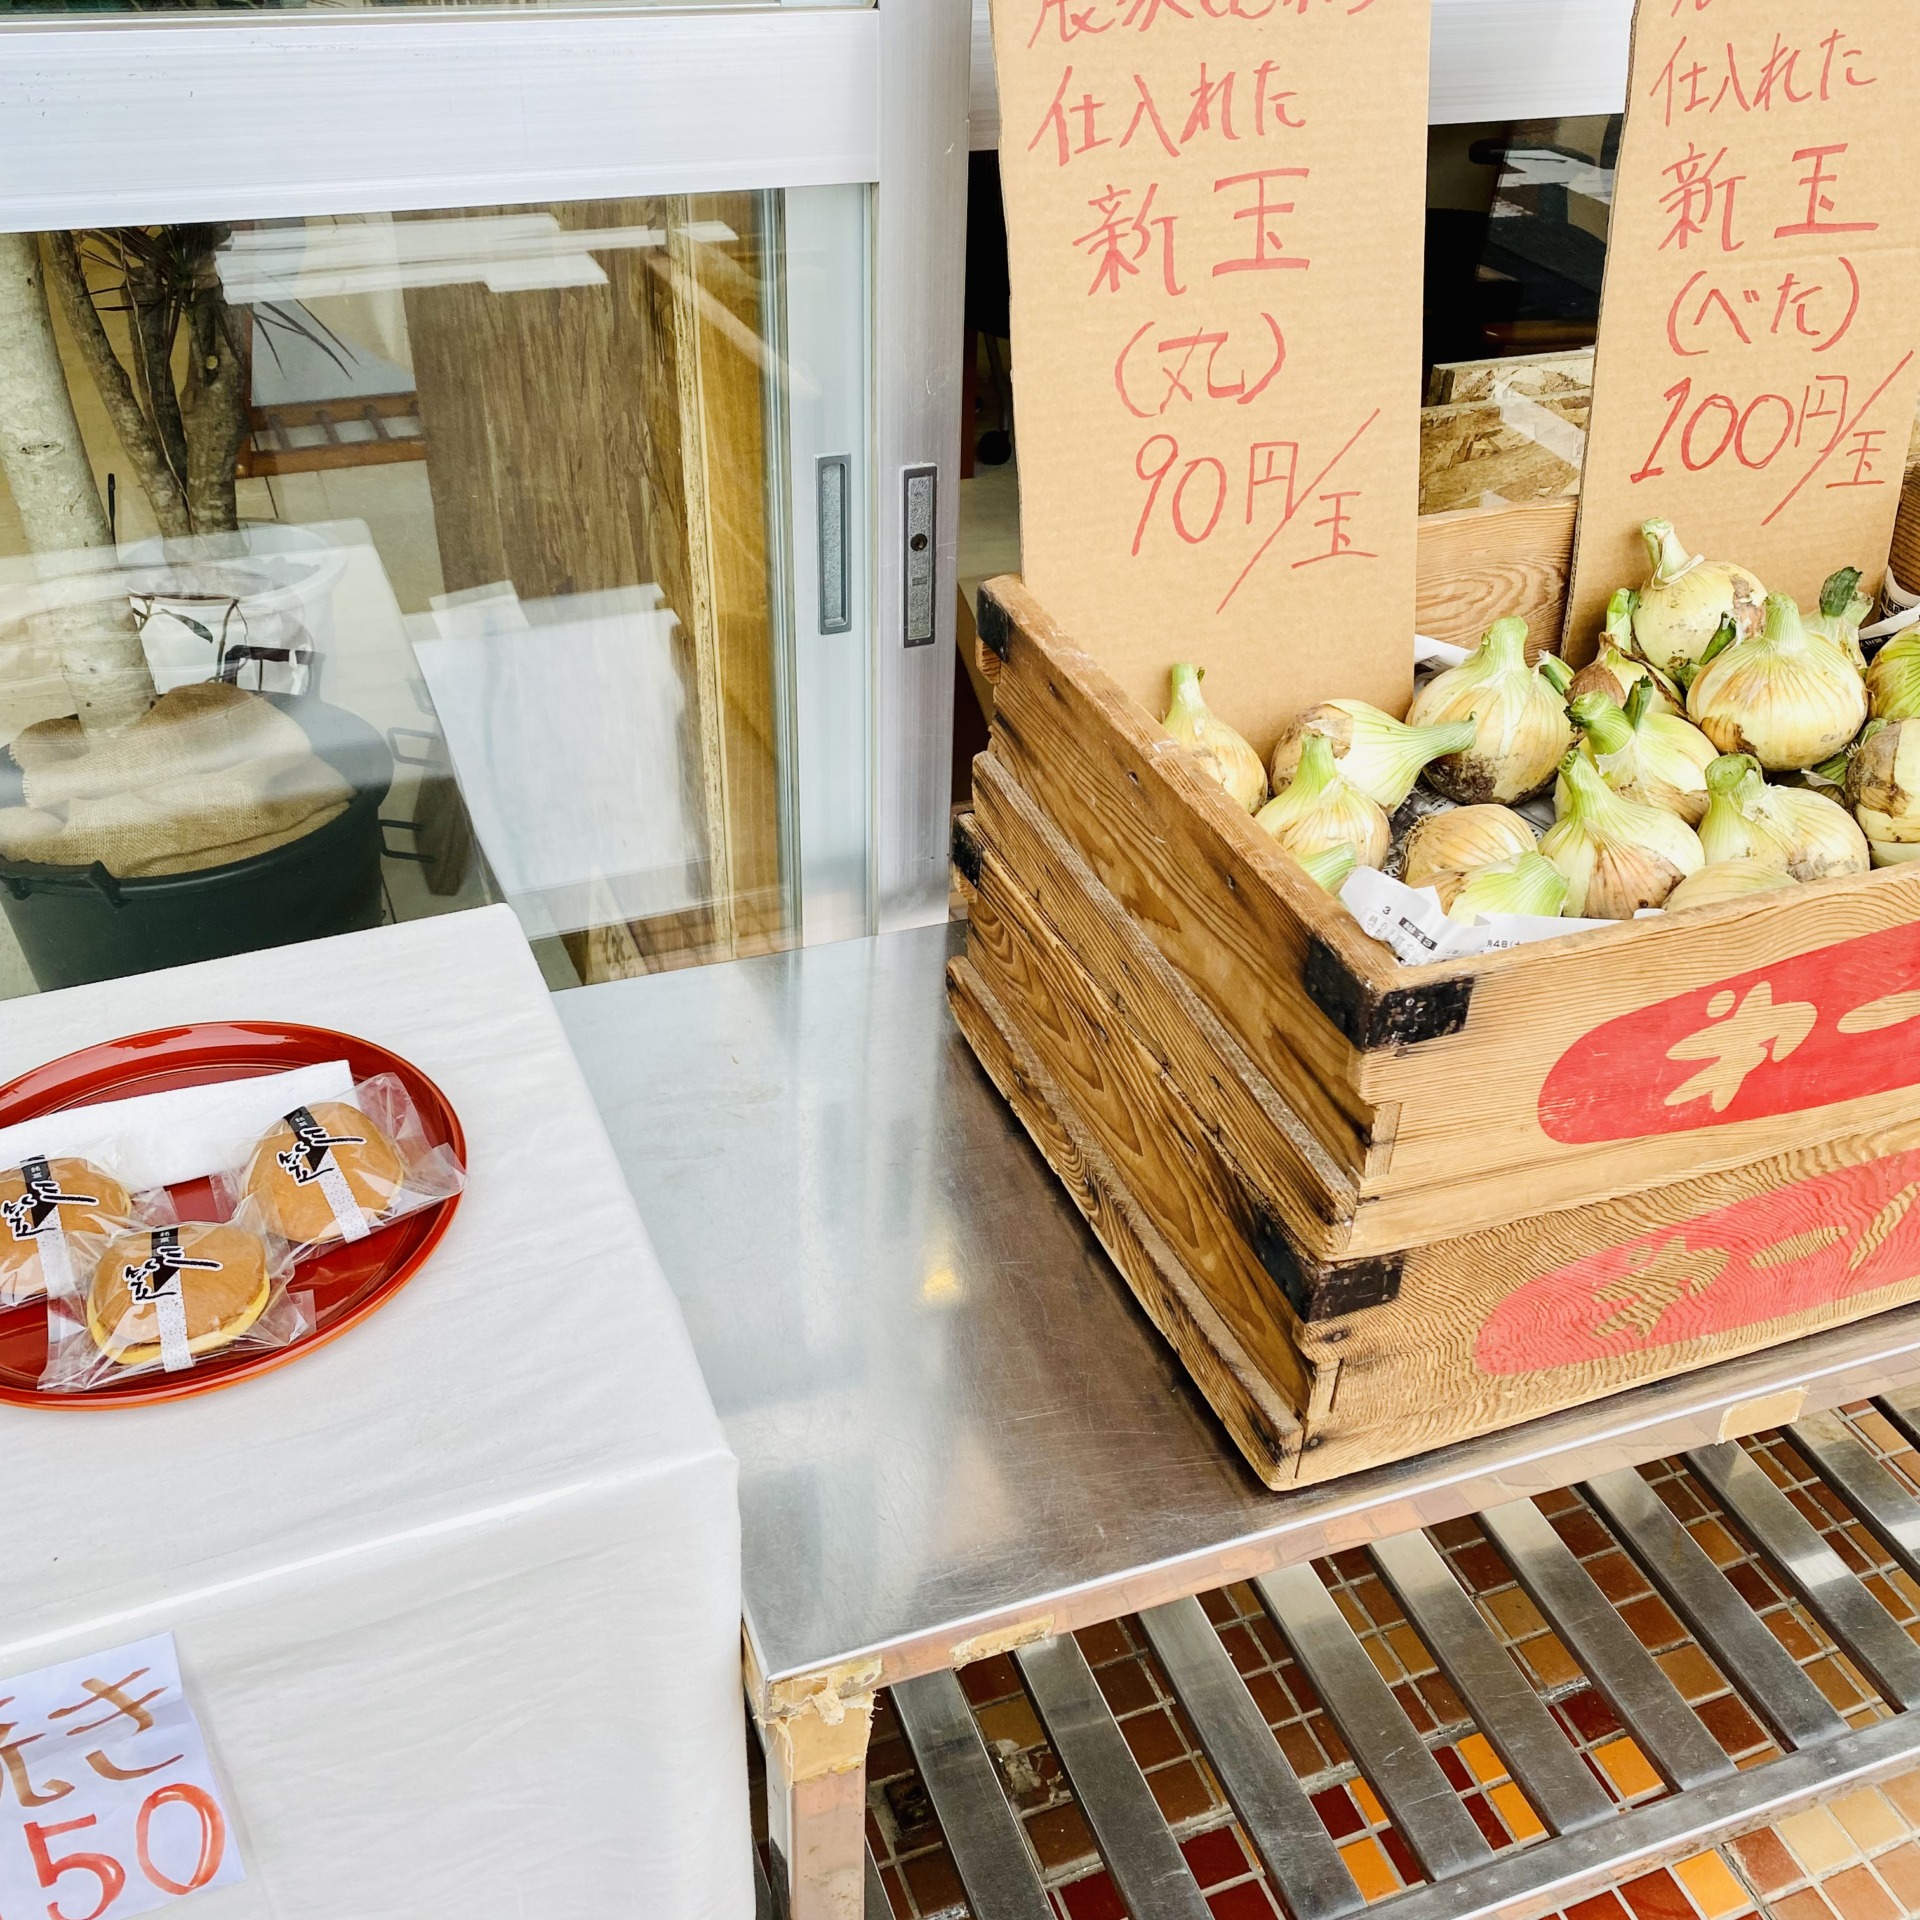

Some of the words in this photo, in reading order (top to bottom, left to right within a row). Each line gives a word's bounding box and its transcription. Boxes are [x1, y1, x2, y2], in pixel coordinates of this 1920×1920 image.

[1028, 60, 1306, 166] 仕入れた
[1650, 29, 1877, 126] 仕入れた
[1072, 168, 1310, 296] 新玉
[1658, 142, 1879, 251] 新玉
